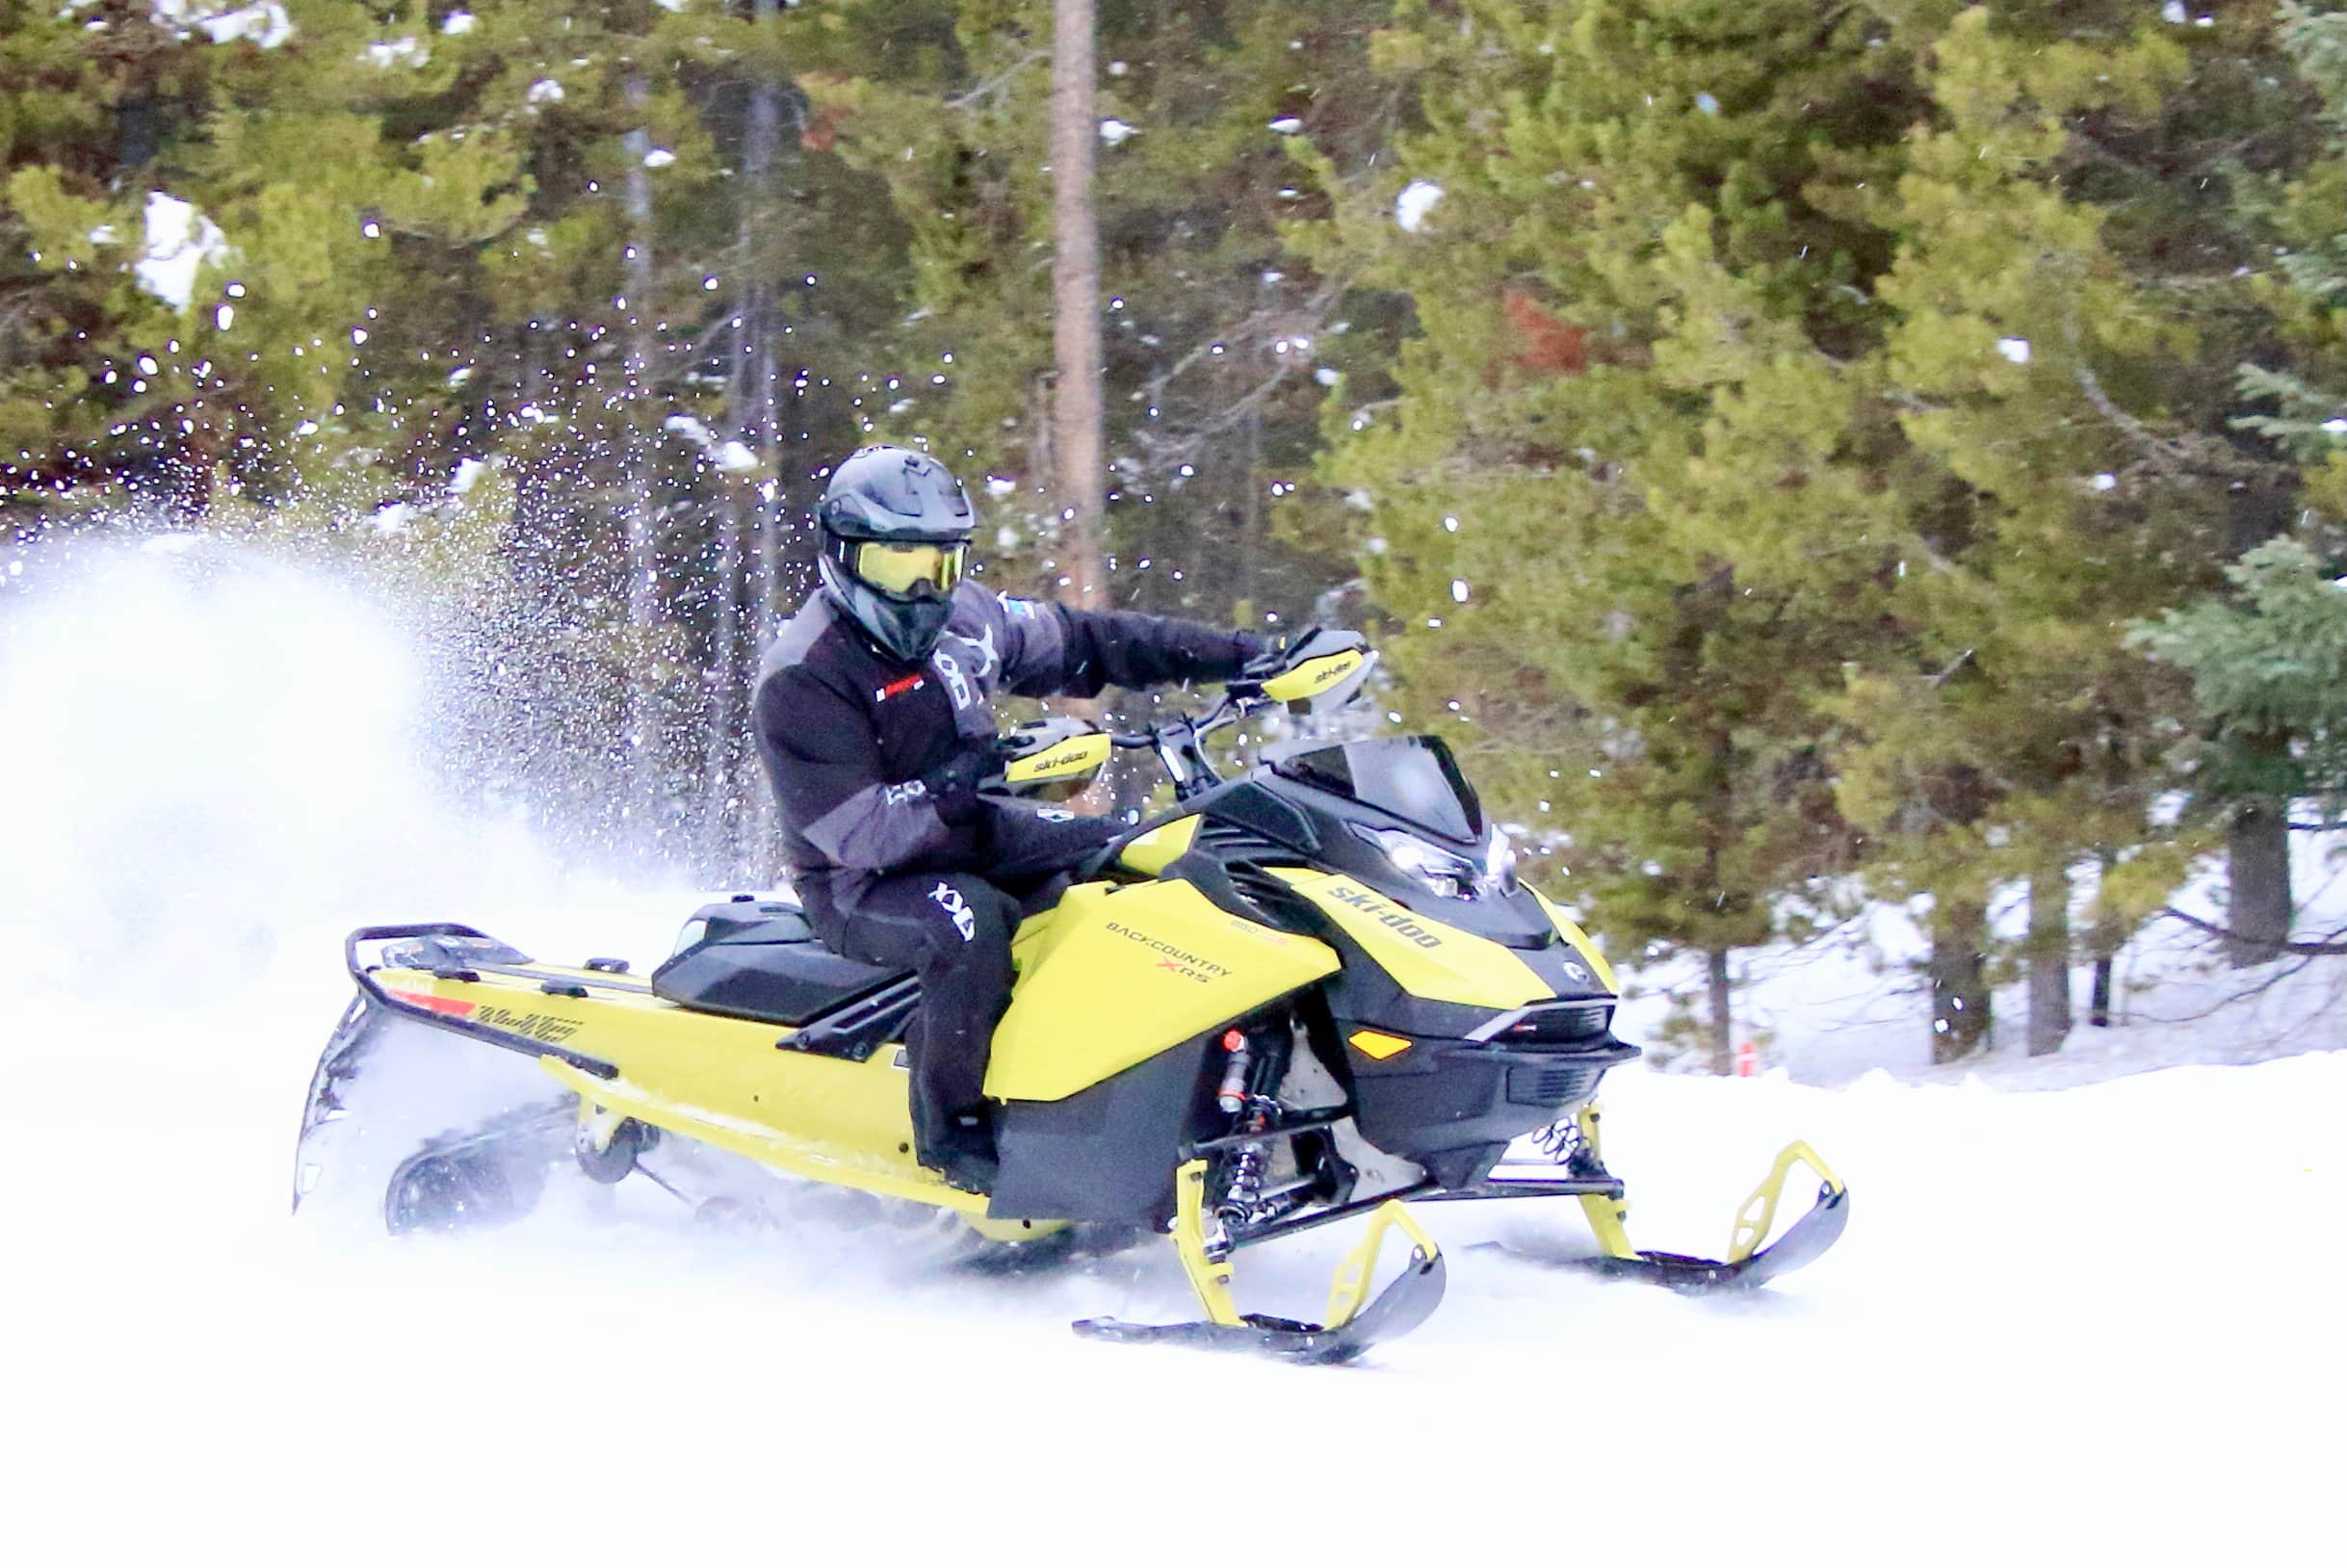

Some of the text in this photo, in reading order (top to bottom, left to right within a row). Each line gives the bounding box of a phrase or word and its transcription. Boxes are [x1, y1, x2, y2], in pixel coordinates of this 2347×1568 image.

[1033, 751, 1088, 772] ski-doo
[1327, 886, 1442, 949] ski-doo
[1106, 922, 1233, 977] BACKCOUNTRY
[1156, 956, 1211, 983] XRS
